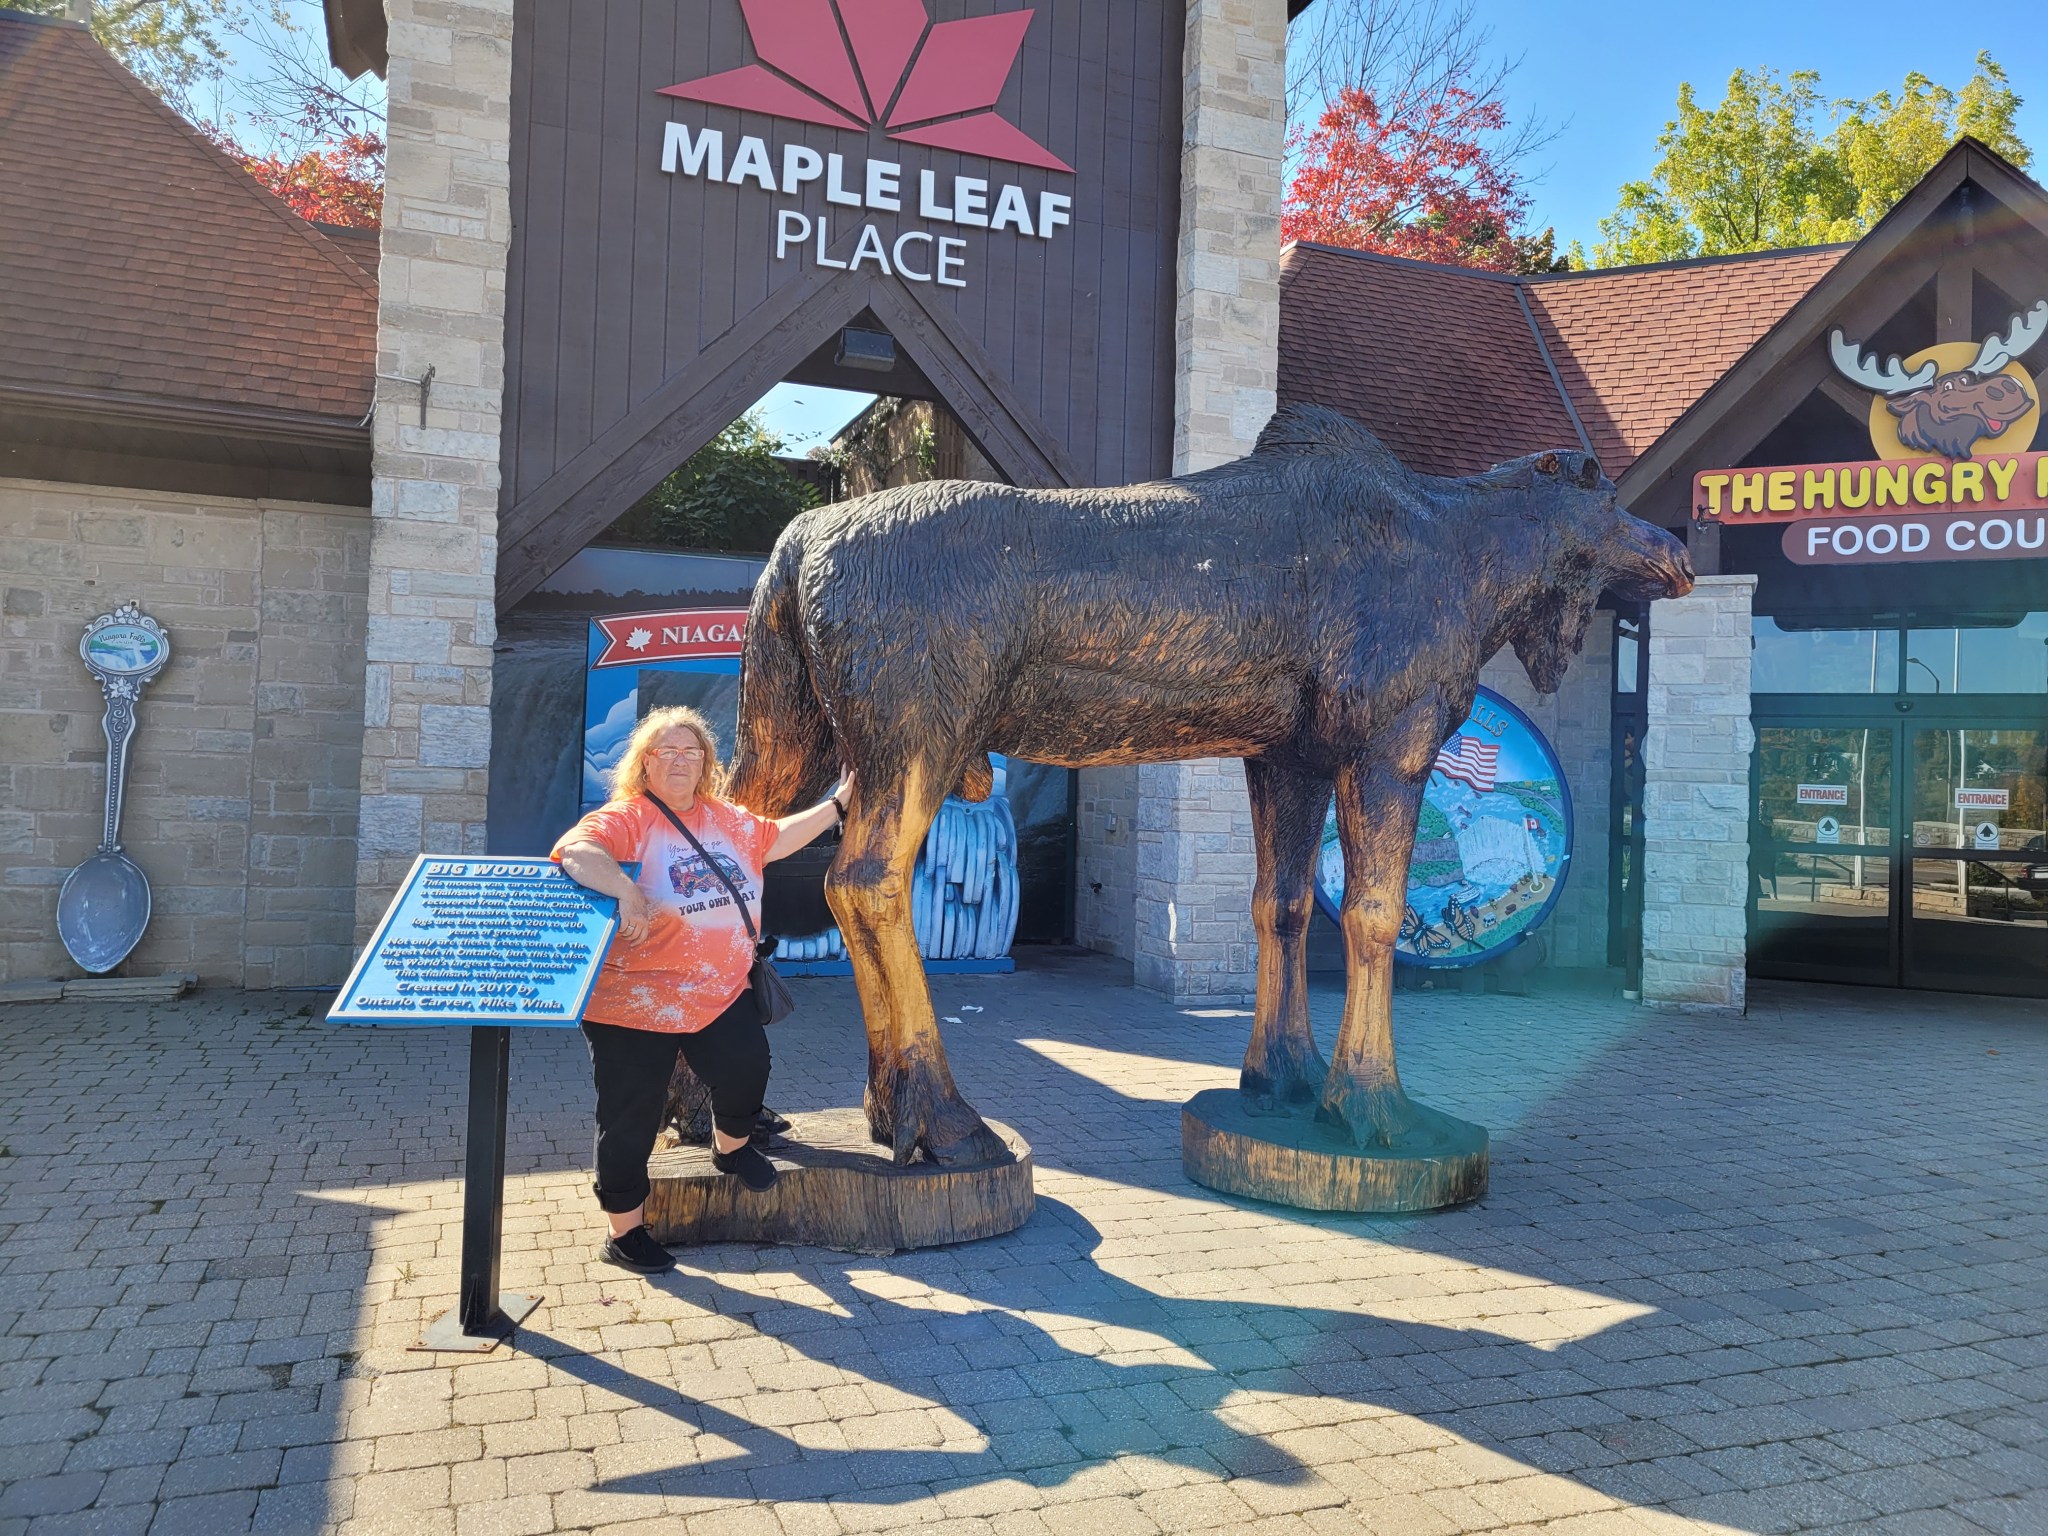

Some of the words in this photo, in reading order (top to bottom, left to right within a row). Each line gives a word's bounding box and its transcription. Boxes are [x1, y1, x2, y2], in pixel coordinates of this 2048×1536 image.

[661, 121, 901, 211] MAPLE
[919, 169, 1072, 239] LEAF
[776, 209, 967, 287] PLACE
[1700, 471, 1797, 515] THE
[1803, 457, 2019, 510] HUNGRY
[1807, 522, 1930, 557] FOOD
[129, 632, 146, 642] Falls
[660, 623, 745, 646] NIAGA
[1468, 704, 1509, 738] LLS
[1799, 789, 1846, 801] ENTRANCE
[1957, 793, 2007, 805] ENTRANCE
[667, 843, 689, 858] You
[427, 863, 466, 876] BIG
[474, 864, 540, 877] WOOD
[422, 879, 443, 887] This
[480, 890, 507, 898] using
[678, 901, 706, 916] YOUR
[708, 896, 731, 909] OWN
[734, 891, 756, 904] AY
[509, 910, 575, 918] cottonwood
[411, 918, 432, 926] logs
[547, 920, 560, 928] to
[447, 929, 477, 937] years
[411, 938, 434, 946] only
[458, 938, 489, 946] these
[523, 940, 553, 948] some
[380, 948, 417, 956] largest
[420, 948, 439, 956] left
[527, 951, 548, 959] this
[563, 952, 585, 960] also
[405, 958, 447, 966] World's
[450, 959, 488, 968] largest
[490, 960, 532, 968] carved
[394, 969, 416, 977] This
[420, 969, 471, 977] chainsaw
[473, 971, 527, 979] sculpture
[396, 982, 457, 992] Created
[459, 983, 473, 992] in
[477, 983, 514, 992] 2017
[518, 984, 534, 995] by
[355, 996, 413, 1006] Ontario
[419, 996, 473, 1008] Carver,
[478, 997, 515, 1007] Mike
[520, 998, 561, 1009] Winia
